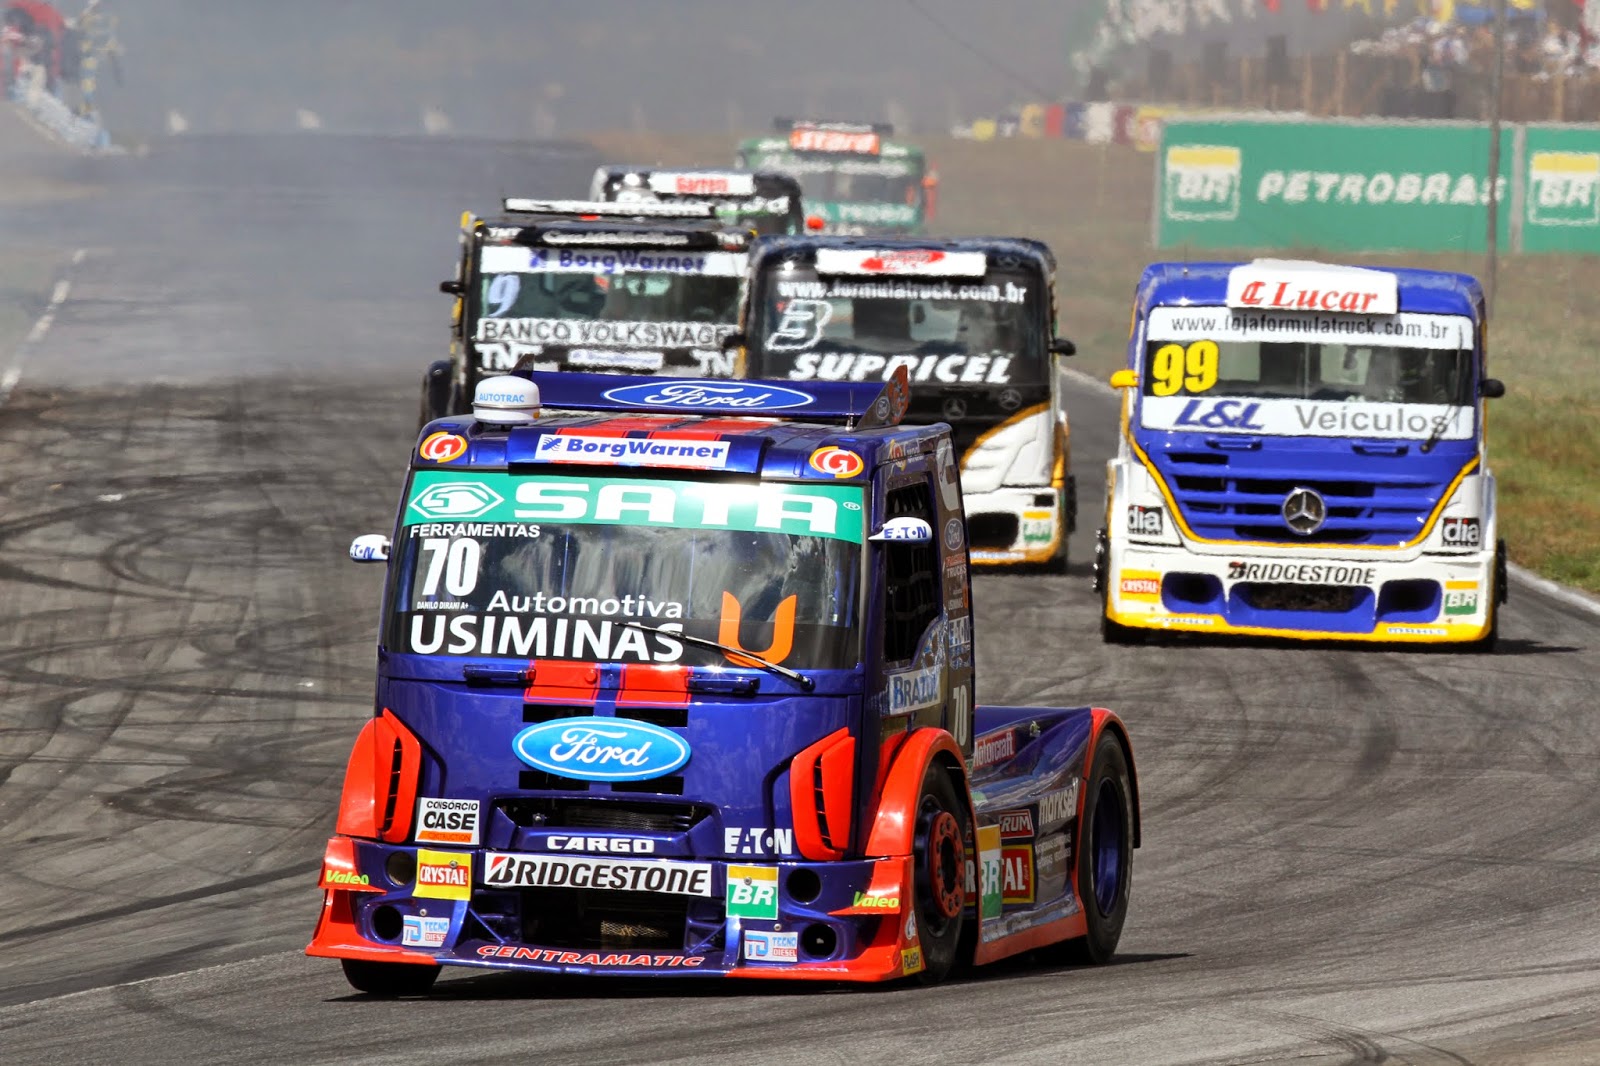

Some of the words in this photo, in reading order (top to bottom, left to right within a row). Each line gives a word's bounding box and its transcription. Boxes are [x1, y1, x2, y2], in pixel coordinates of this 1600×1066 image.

[1178, 168, 1229, 202] BR
[1257, 170, 1507, 205] PETROBRAS
[1538, 174, 1593, 206] BR
[559, 249, 705, 274] BorgWarner
[488, 273, 521, 318] 9
[1269, 281, 1379, 312] Lucar
[484, 320, 571, 340] BANCO
[579, 321, 730, 347] VOLKSWAGE
[1171, 312, 1449, 340] www.lojaformulatruck.com.br
[689, 348, 738, 376] TN
[788, 351, 1011, 384] SUPRICEL
[1152, 339, 1220, 397] 99
[479, 392, 525, 403] AUTOTRAC
[643, 383, 773, 407] Ford
[1173, 399, 1265, 430] L&L
[566, 438, 724, 460] BorgWarner
[514, 481, 838, 535] SATA
[1128, 505, 1161, 530] dia
[410, 523, 541, 539] FERRAMENTAS
[1443, 518, 1480, 542] dia
[422, 537, 481, 597] 70
[1228, 560, 1377, 585] BRIDGESTONE
[487, 590, 683, 619] Automotiva
[1446, 592, 1477, 607] BR
[410, 613, 685, 662] USIMINAS
[549, 726, 653, 767] Ford
[423, 811, 477, 831] CASE
[547, 835, 655, 854] CARGO
[325, 870, 369, 885] Valeo
[420, 865, 466, 885] CRYSTAL
[487, 856, 709, 894] BRIDGESTONE
[731, 883, 775, 906] BR
[852, 891, 900, 909] Valeo
[772, 936, 797, 947] TECNO
[772, 947, 797, 958] DIESEL
[476, 944, 705, 968] CENTRAMATIC
